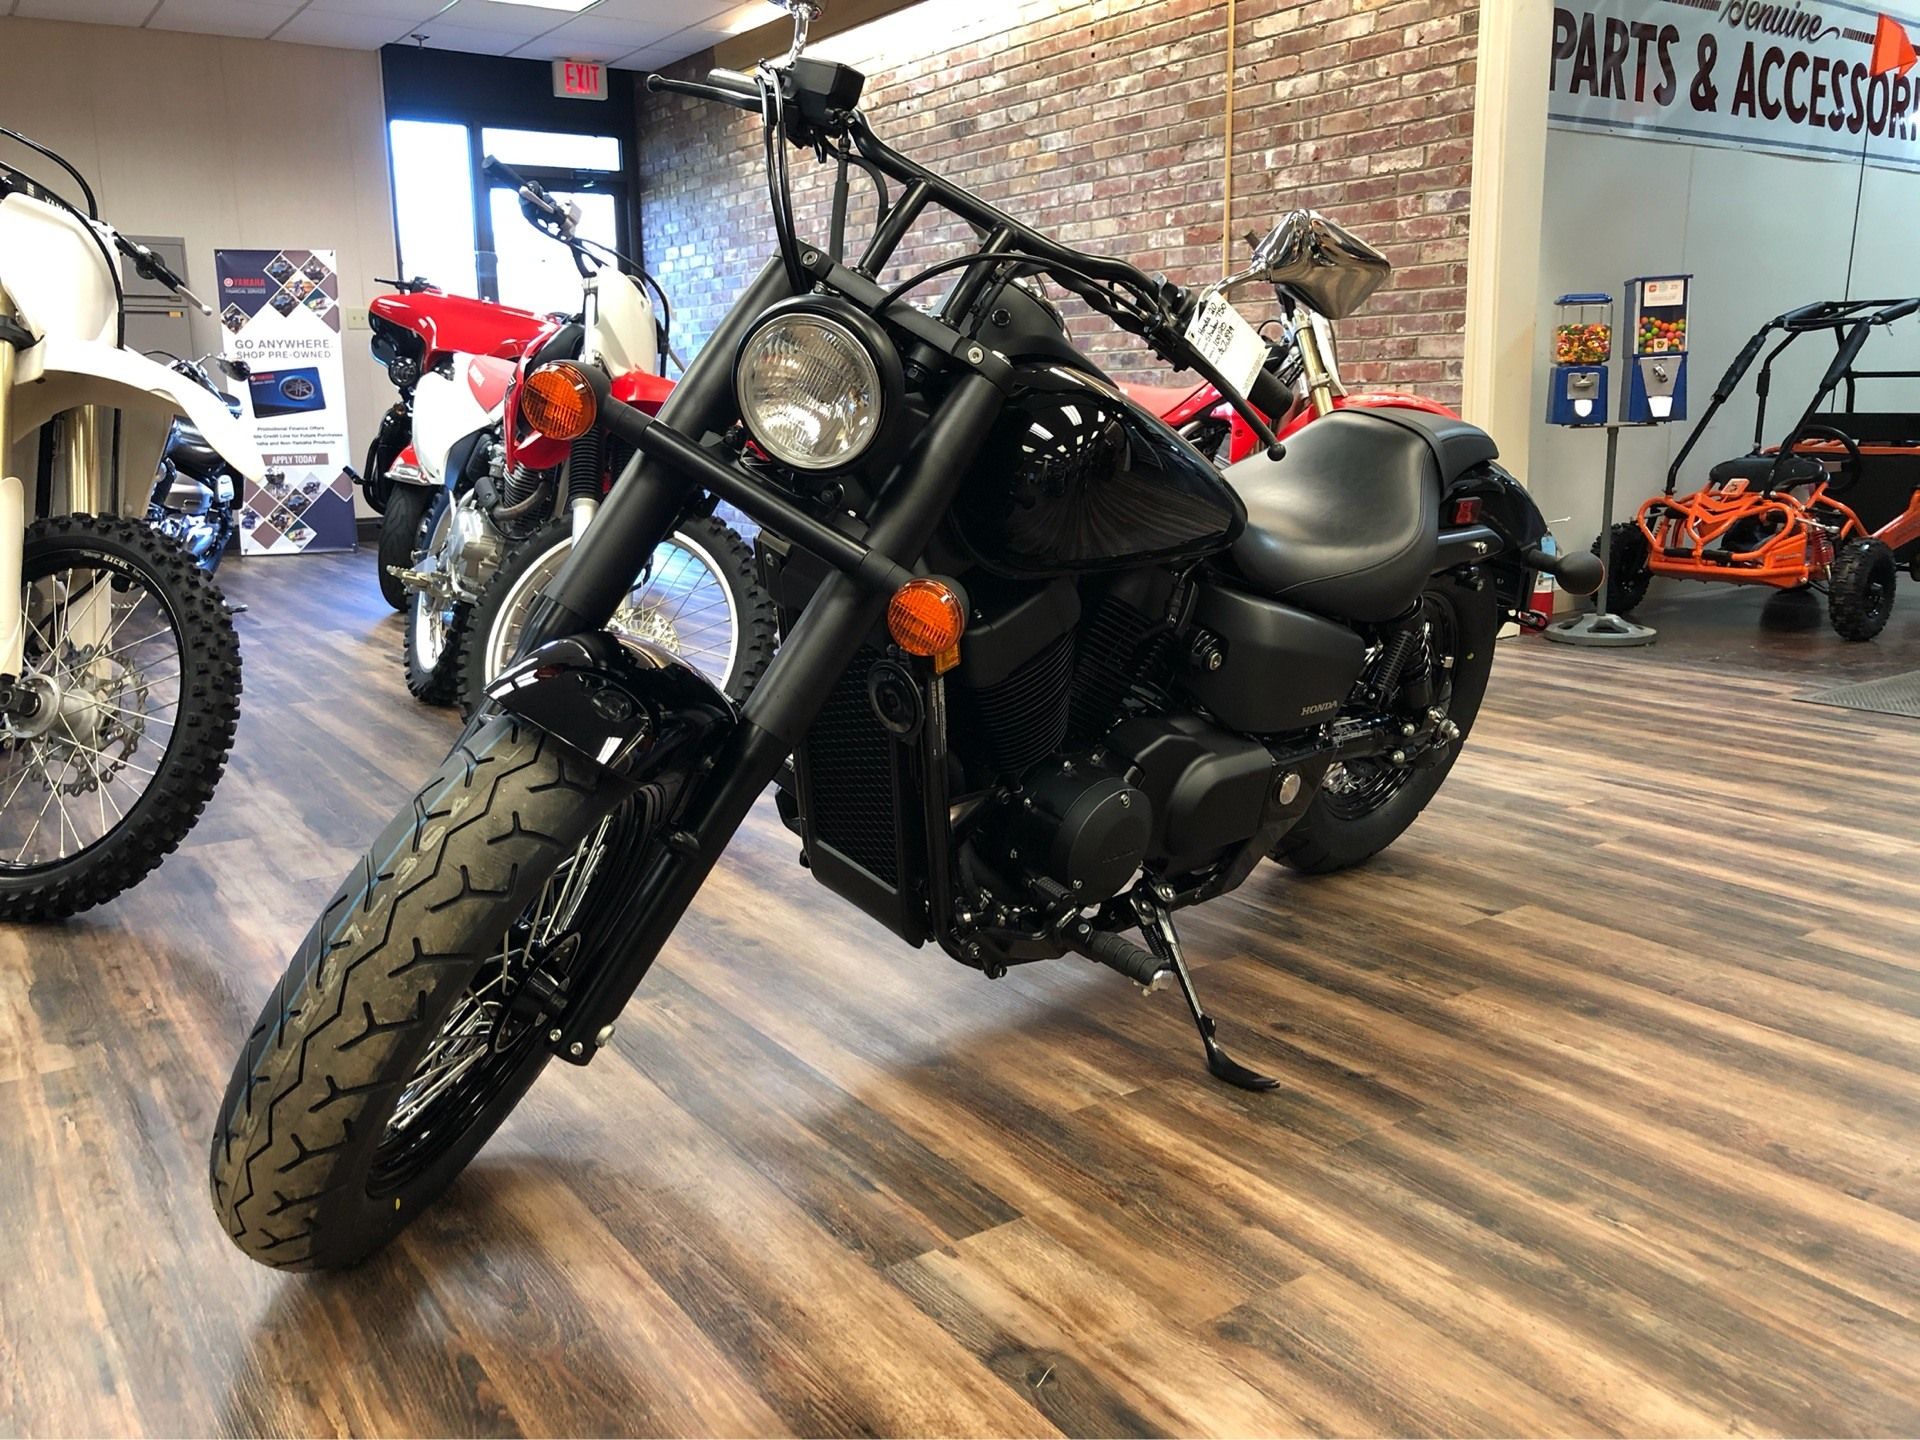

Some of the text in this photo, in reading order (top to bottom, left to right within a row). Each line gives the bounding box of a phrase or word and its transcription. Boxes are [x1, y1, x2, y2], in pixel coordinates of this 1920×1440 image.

[1549, 8, 1681, 107] PARTS
[1689, 33, 1719, 112] &
[564, 63, 599, 96] EXIT
[234, 339, 254, 349] GO
[236, 350, 331, 359] SHOP PRE-OWNED
[271, 455, 317, 465] APPLY TODAY
[1300, 700, 1338, 716] HONDA
